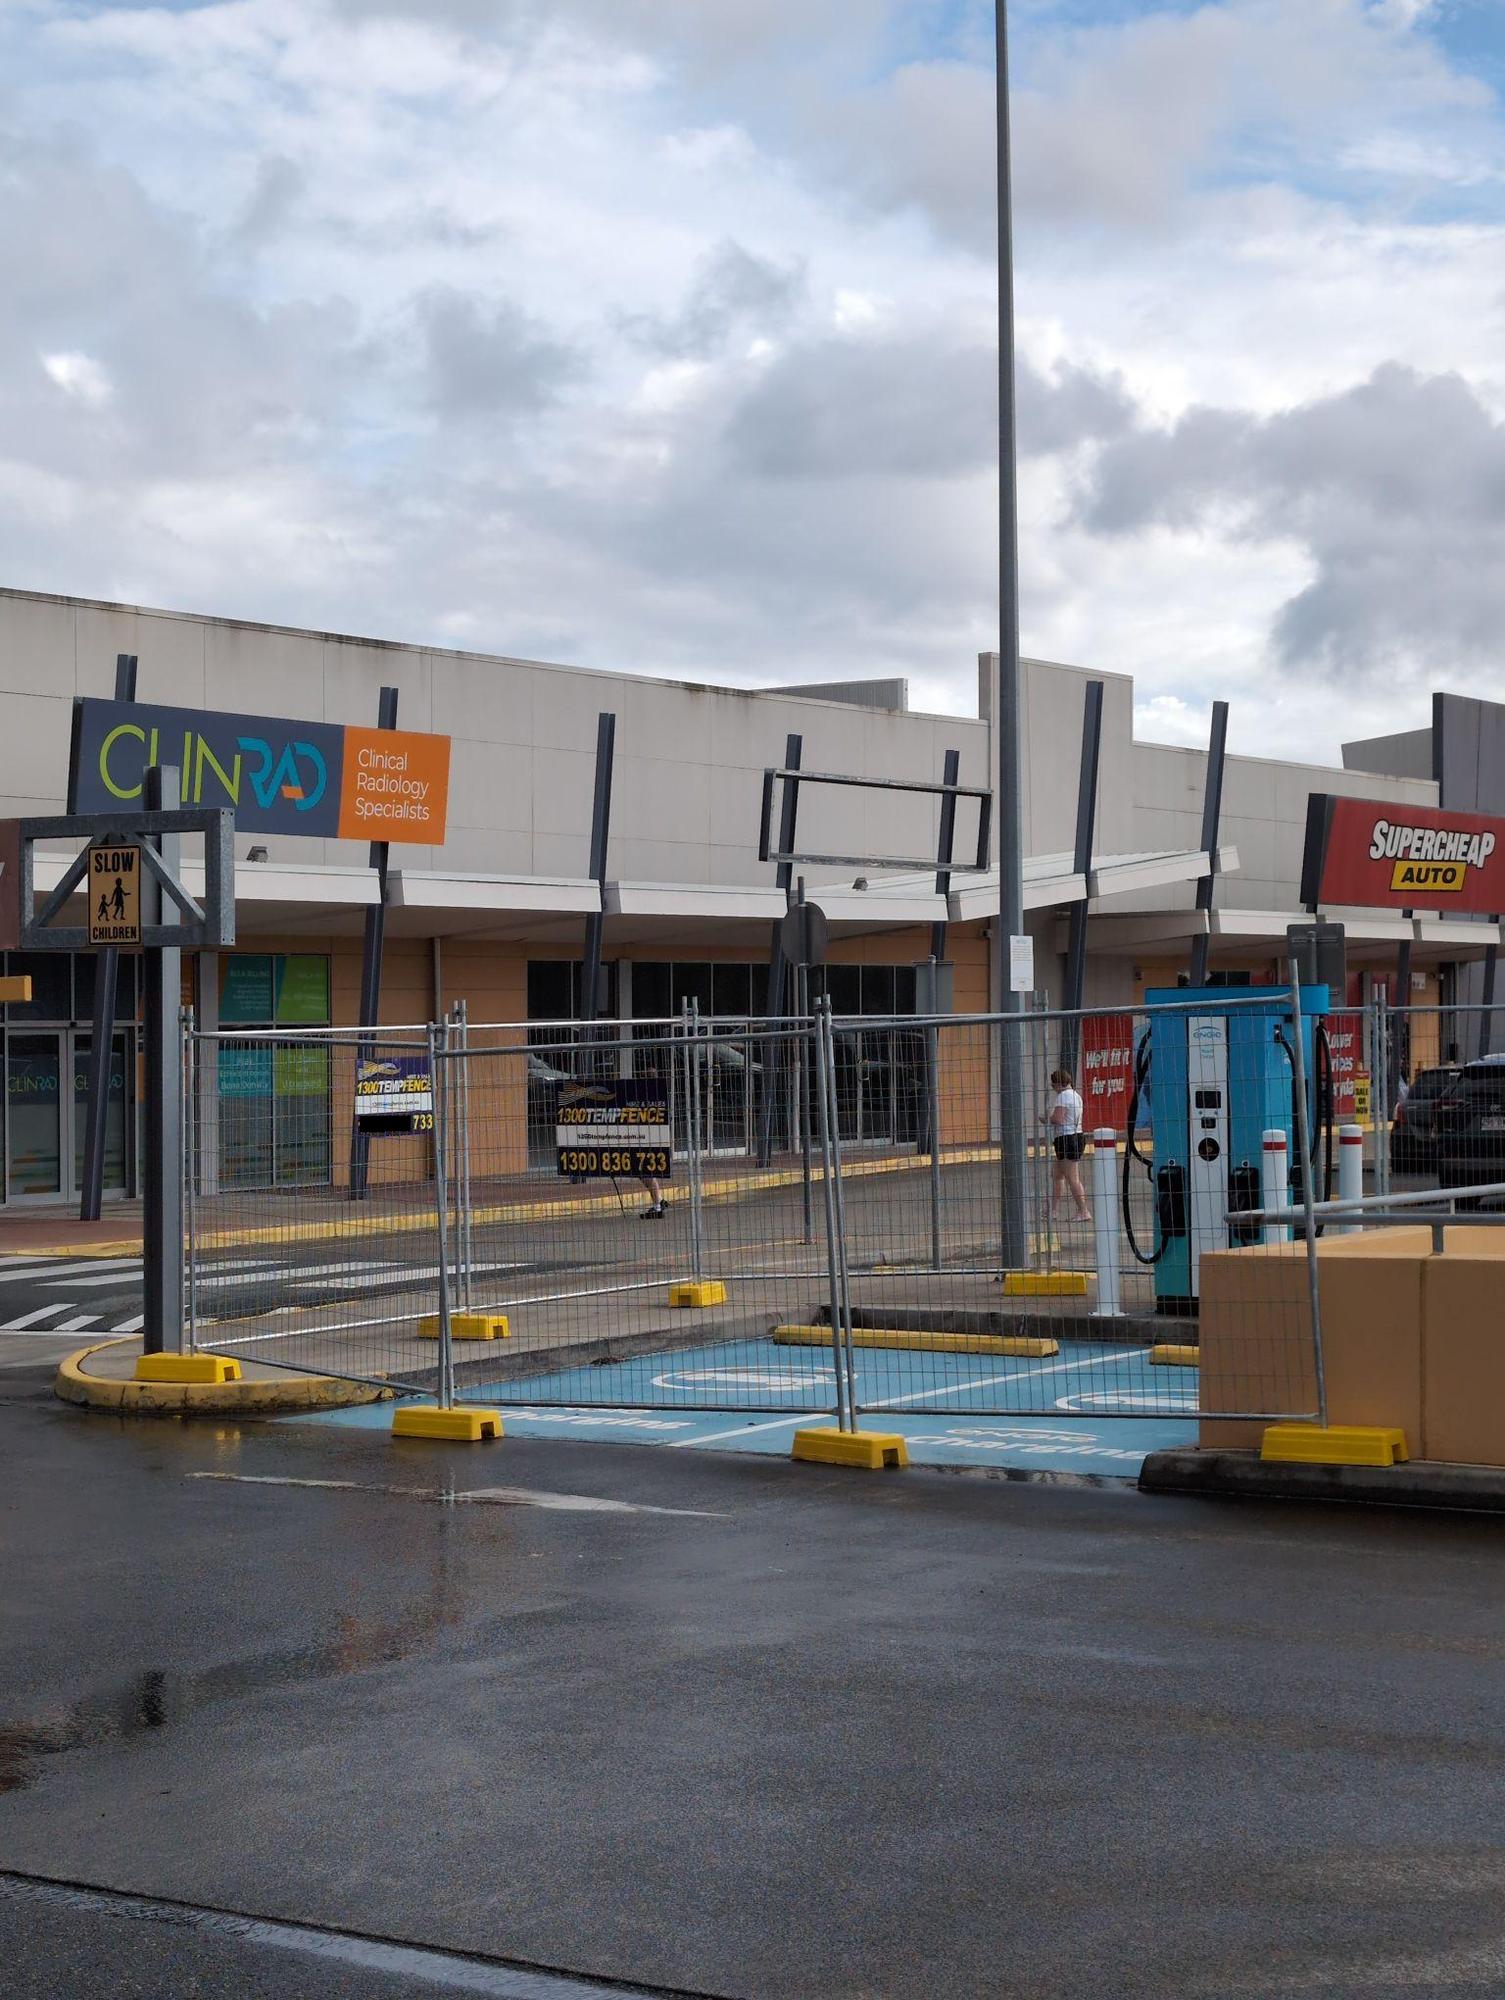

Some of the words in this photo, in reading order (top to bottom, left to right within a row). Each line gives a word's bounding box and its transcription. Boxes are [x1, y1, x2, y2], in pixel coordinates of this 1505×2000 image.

[358, 748, 408, 771] Clinical
[357, 772, 429, 799] Radiology
[355, 797, 430, 820] Specialists
[1369, 820, 1496, 869] SUPERCHEAP
[94, 851, 134, 873] SLOW
[1401, 867, 1457, 884] AUTO
[92, 926, 137, 940] CHILDREN
[1092, 1076, 1106, 1095] for
[1107, 1077, 1125, 1097] you
[413, 1114, 433, 1130] 733
[558, 1107, 665, 1124] 1300TEMPFENCE
[560, 1151, 598, 1171] 1300
[602, 1152, 631, 1171] 836
[636, 1152, 667, 1171] 733
